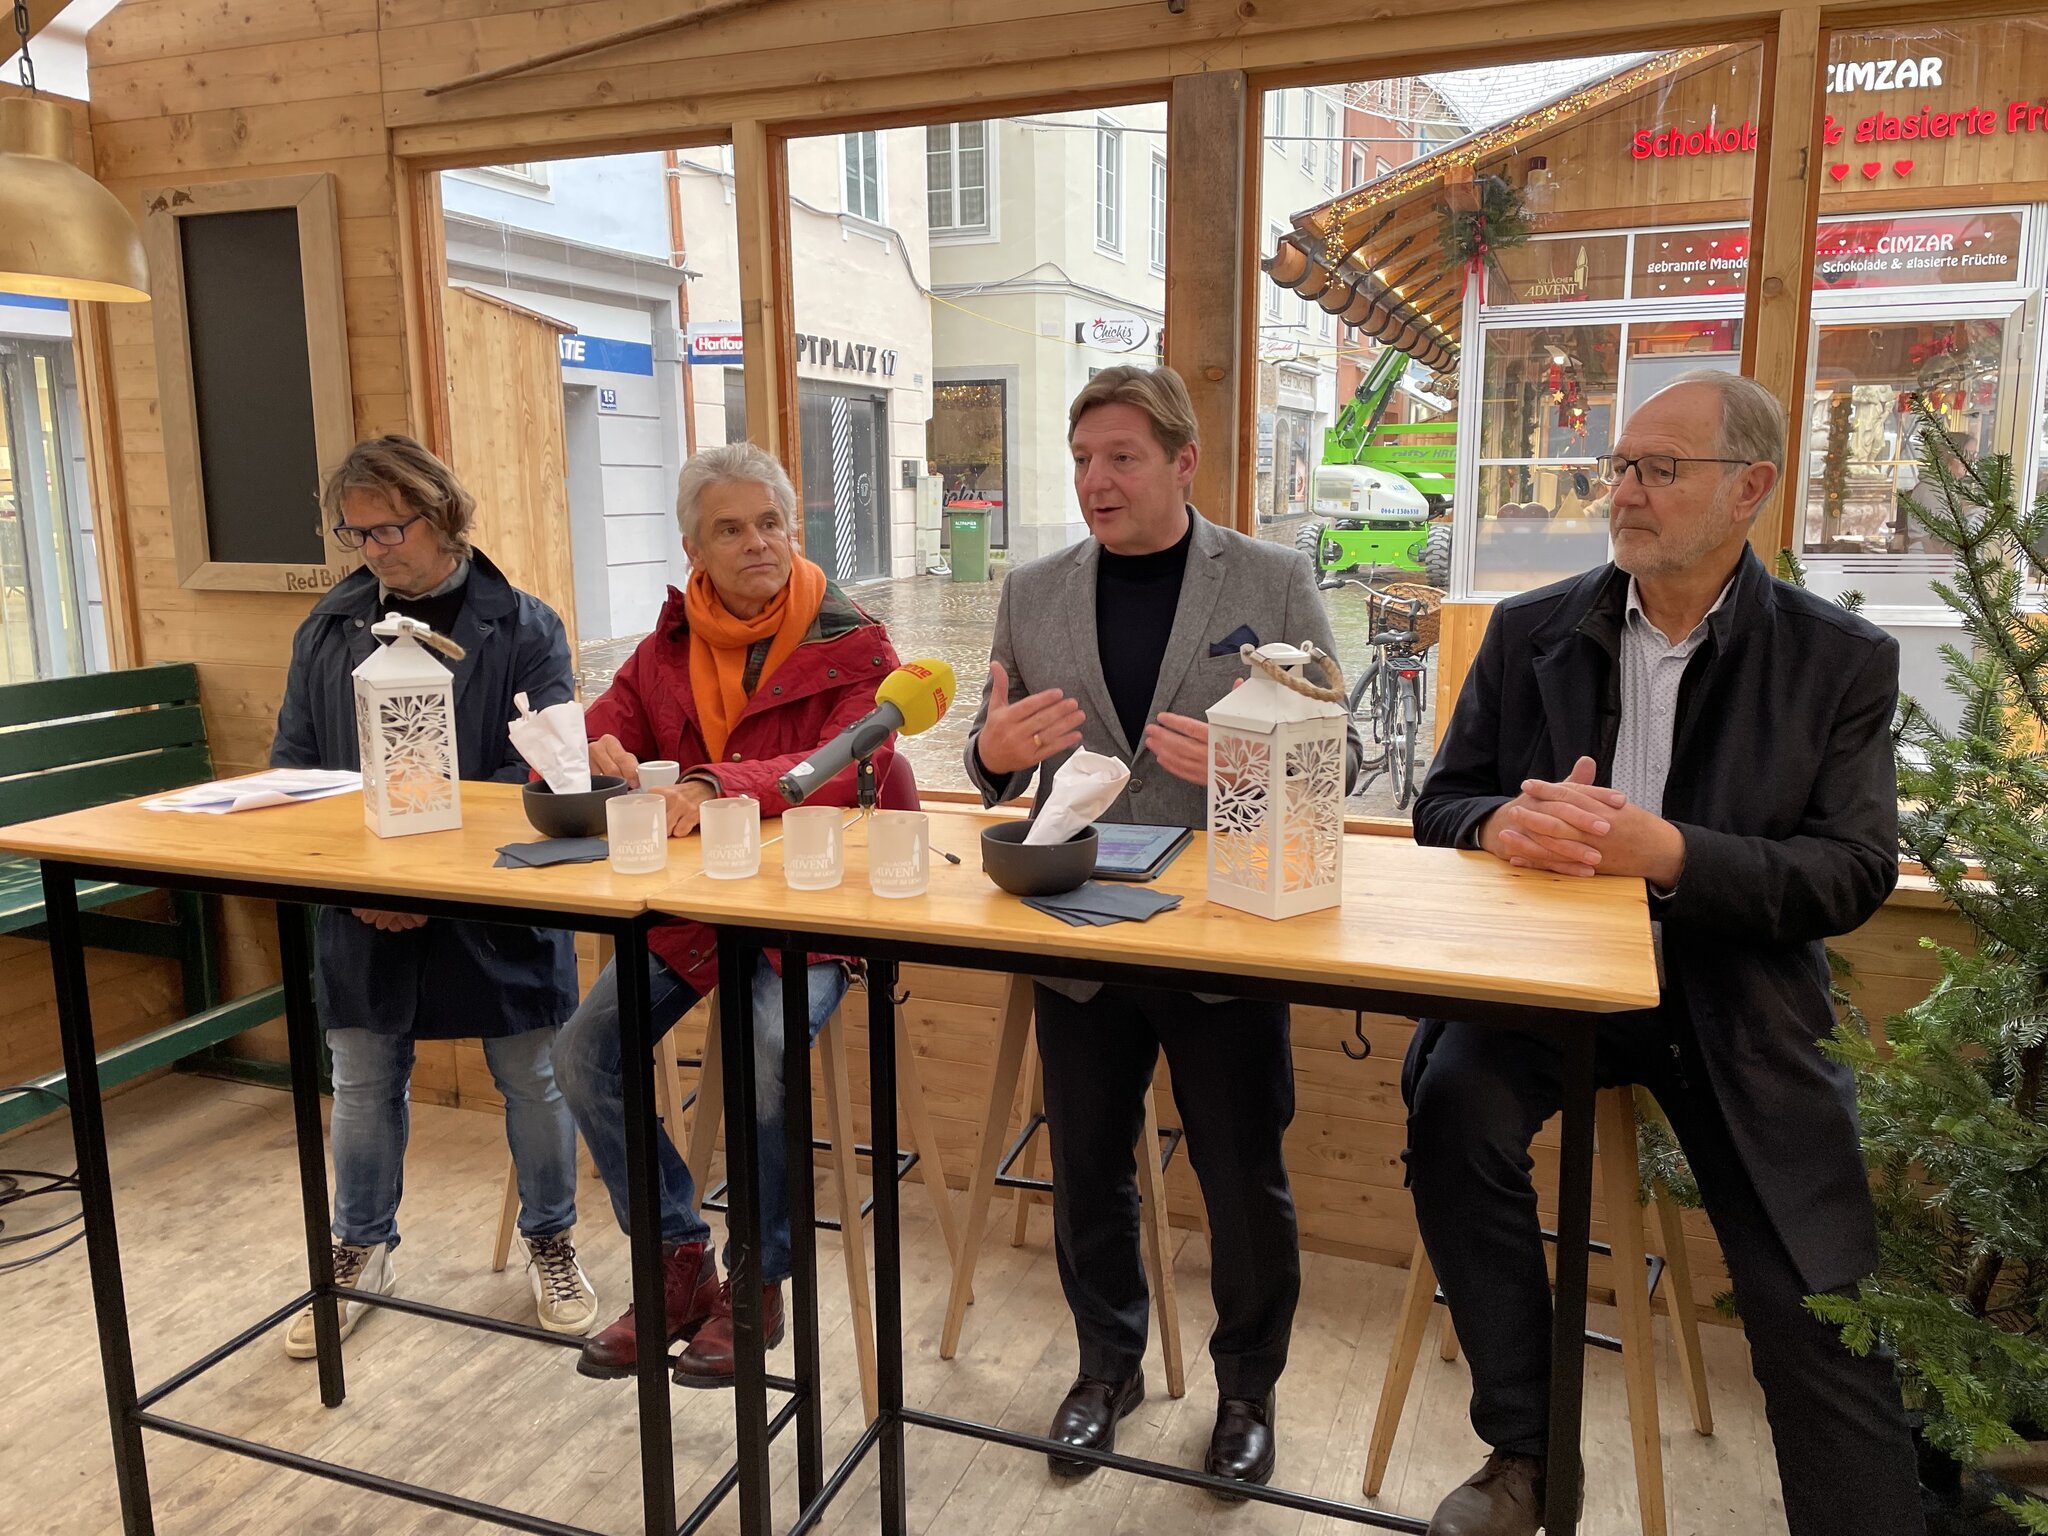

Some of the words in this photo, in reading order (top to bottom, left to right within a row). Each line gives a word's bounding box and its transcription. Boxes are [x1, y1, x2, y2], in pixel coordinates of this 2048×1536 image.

[1855, 105, 1998, 143] glasierte
[2008, 101, 2048, 132] Fr
[1878, 234, 1954, 254] CIMZAR
[1647, 260, 1707, 273] gebrannte
[1822, 259, 1887, 273] Schokolade
[1891, 258, 1903, 269] &
[1907, 256, 1958, 269] glasierte
[1962, 254, 2008, 266] Früchte
[1525, 283, 1578, 296] ADVENT
[881, 349, 898, 376] 17
[603, 390, 614, 403] 15
[285, 568, 318, 591] Red
